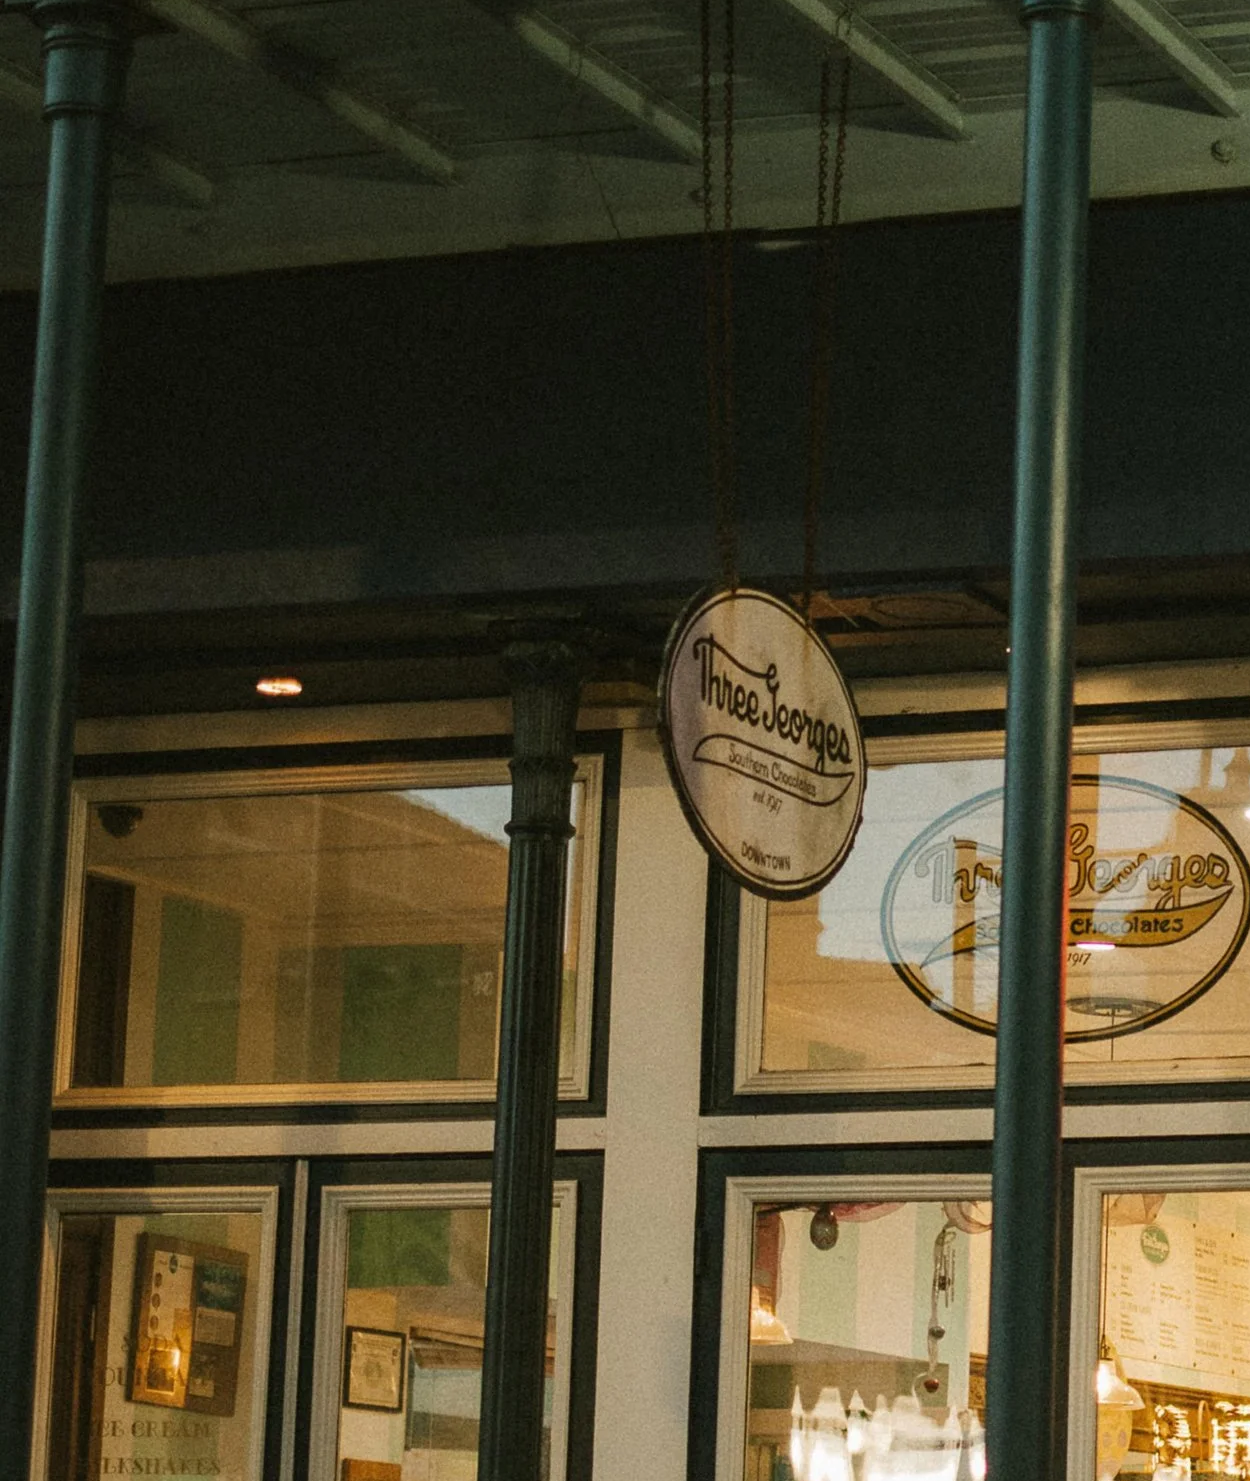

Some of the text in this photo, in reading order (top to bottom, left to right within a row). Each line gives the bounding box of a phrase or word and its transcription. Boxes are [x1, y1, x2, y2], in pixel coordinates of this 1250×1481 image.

[693, 634, 853, 772] Three Georges
[728, 743, 817, 798] Southern Chocolates
[741, 840, 791, 871] DOWNTOWN
[915, 836, 1003, 904] Thr
[131, 1420, 214, 1438] CREAM
[101, 1457, 221, 1476] LKSHAKES
